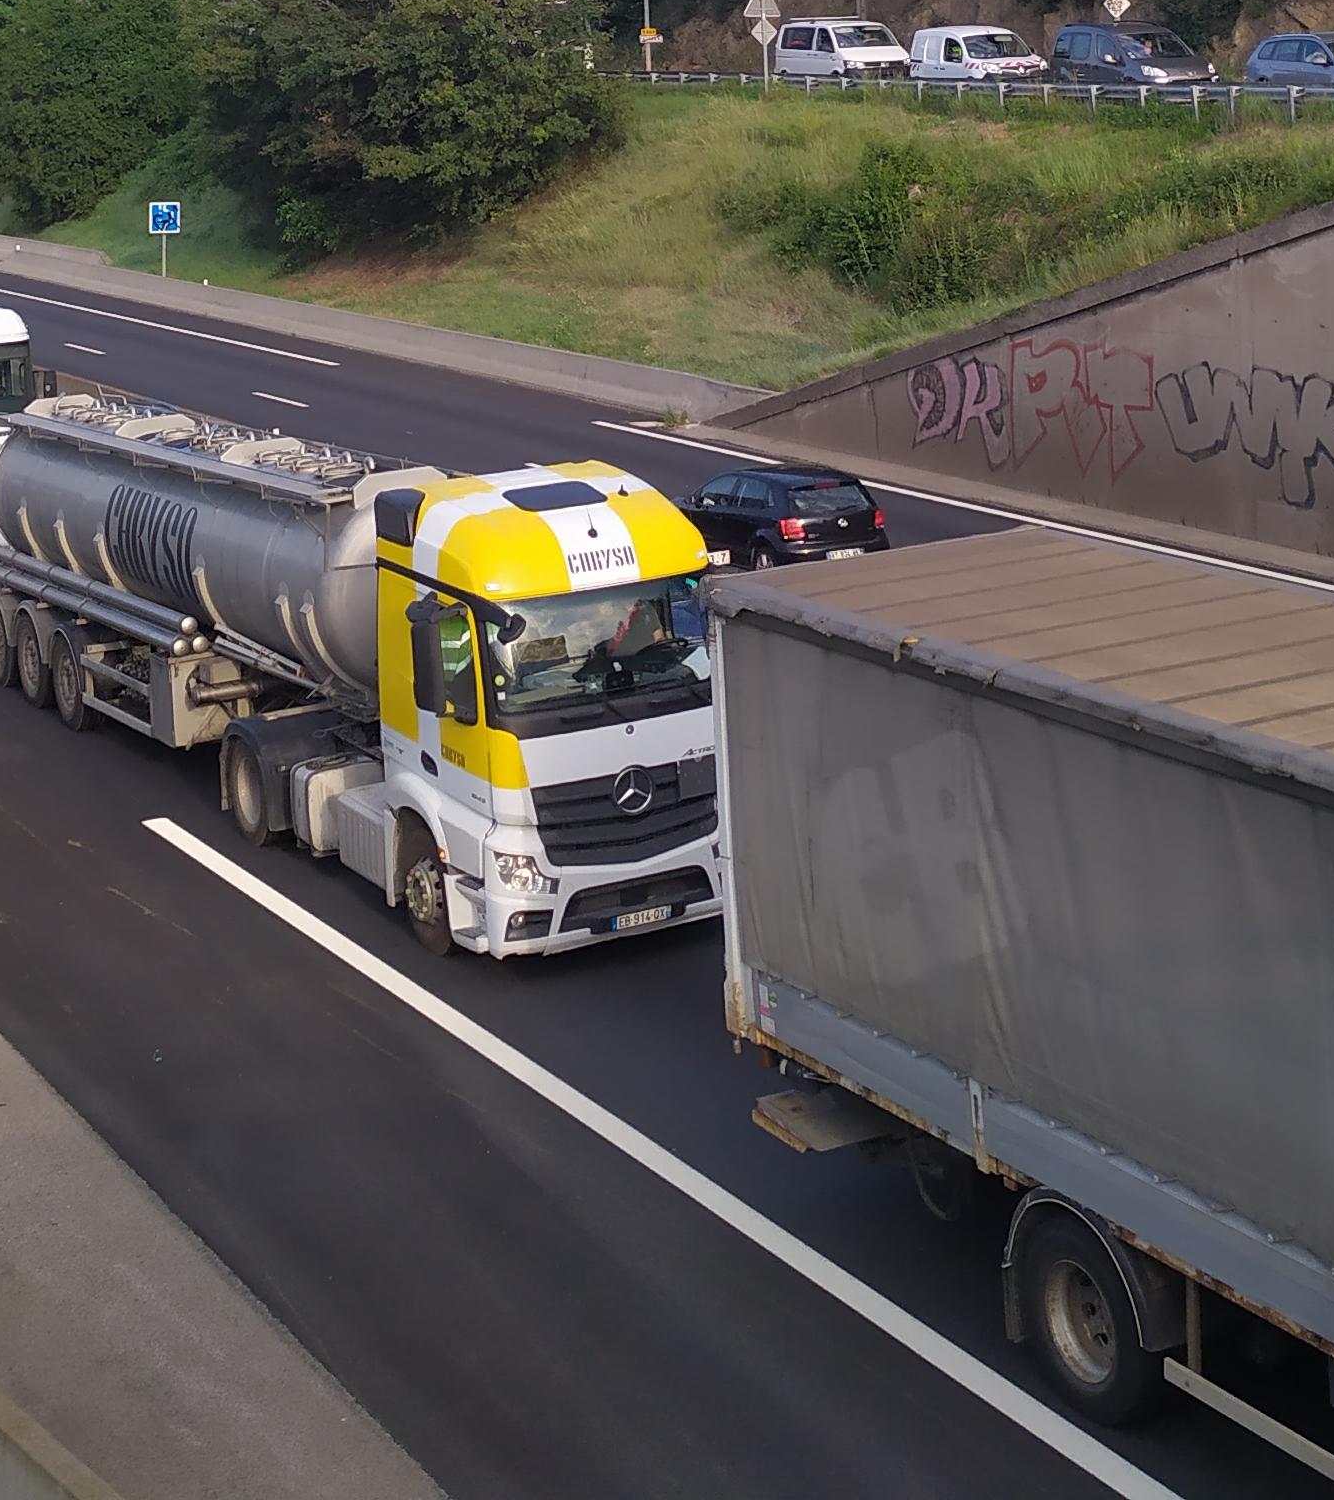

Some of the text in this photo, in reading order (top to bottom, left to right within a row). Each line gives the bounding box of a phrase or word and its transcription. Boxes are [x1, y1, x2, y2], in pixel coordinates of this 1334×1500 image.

[105, 483, 201, 604] CHRYSO
[567, 545, 635, 574] CHRYSO
[681, 745, 716, 757] ACTRO
